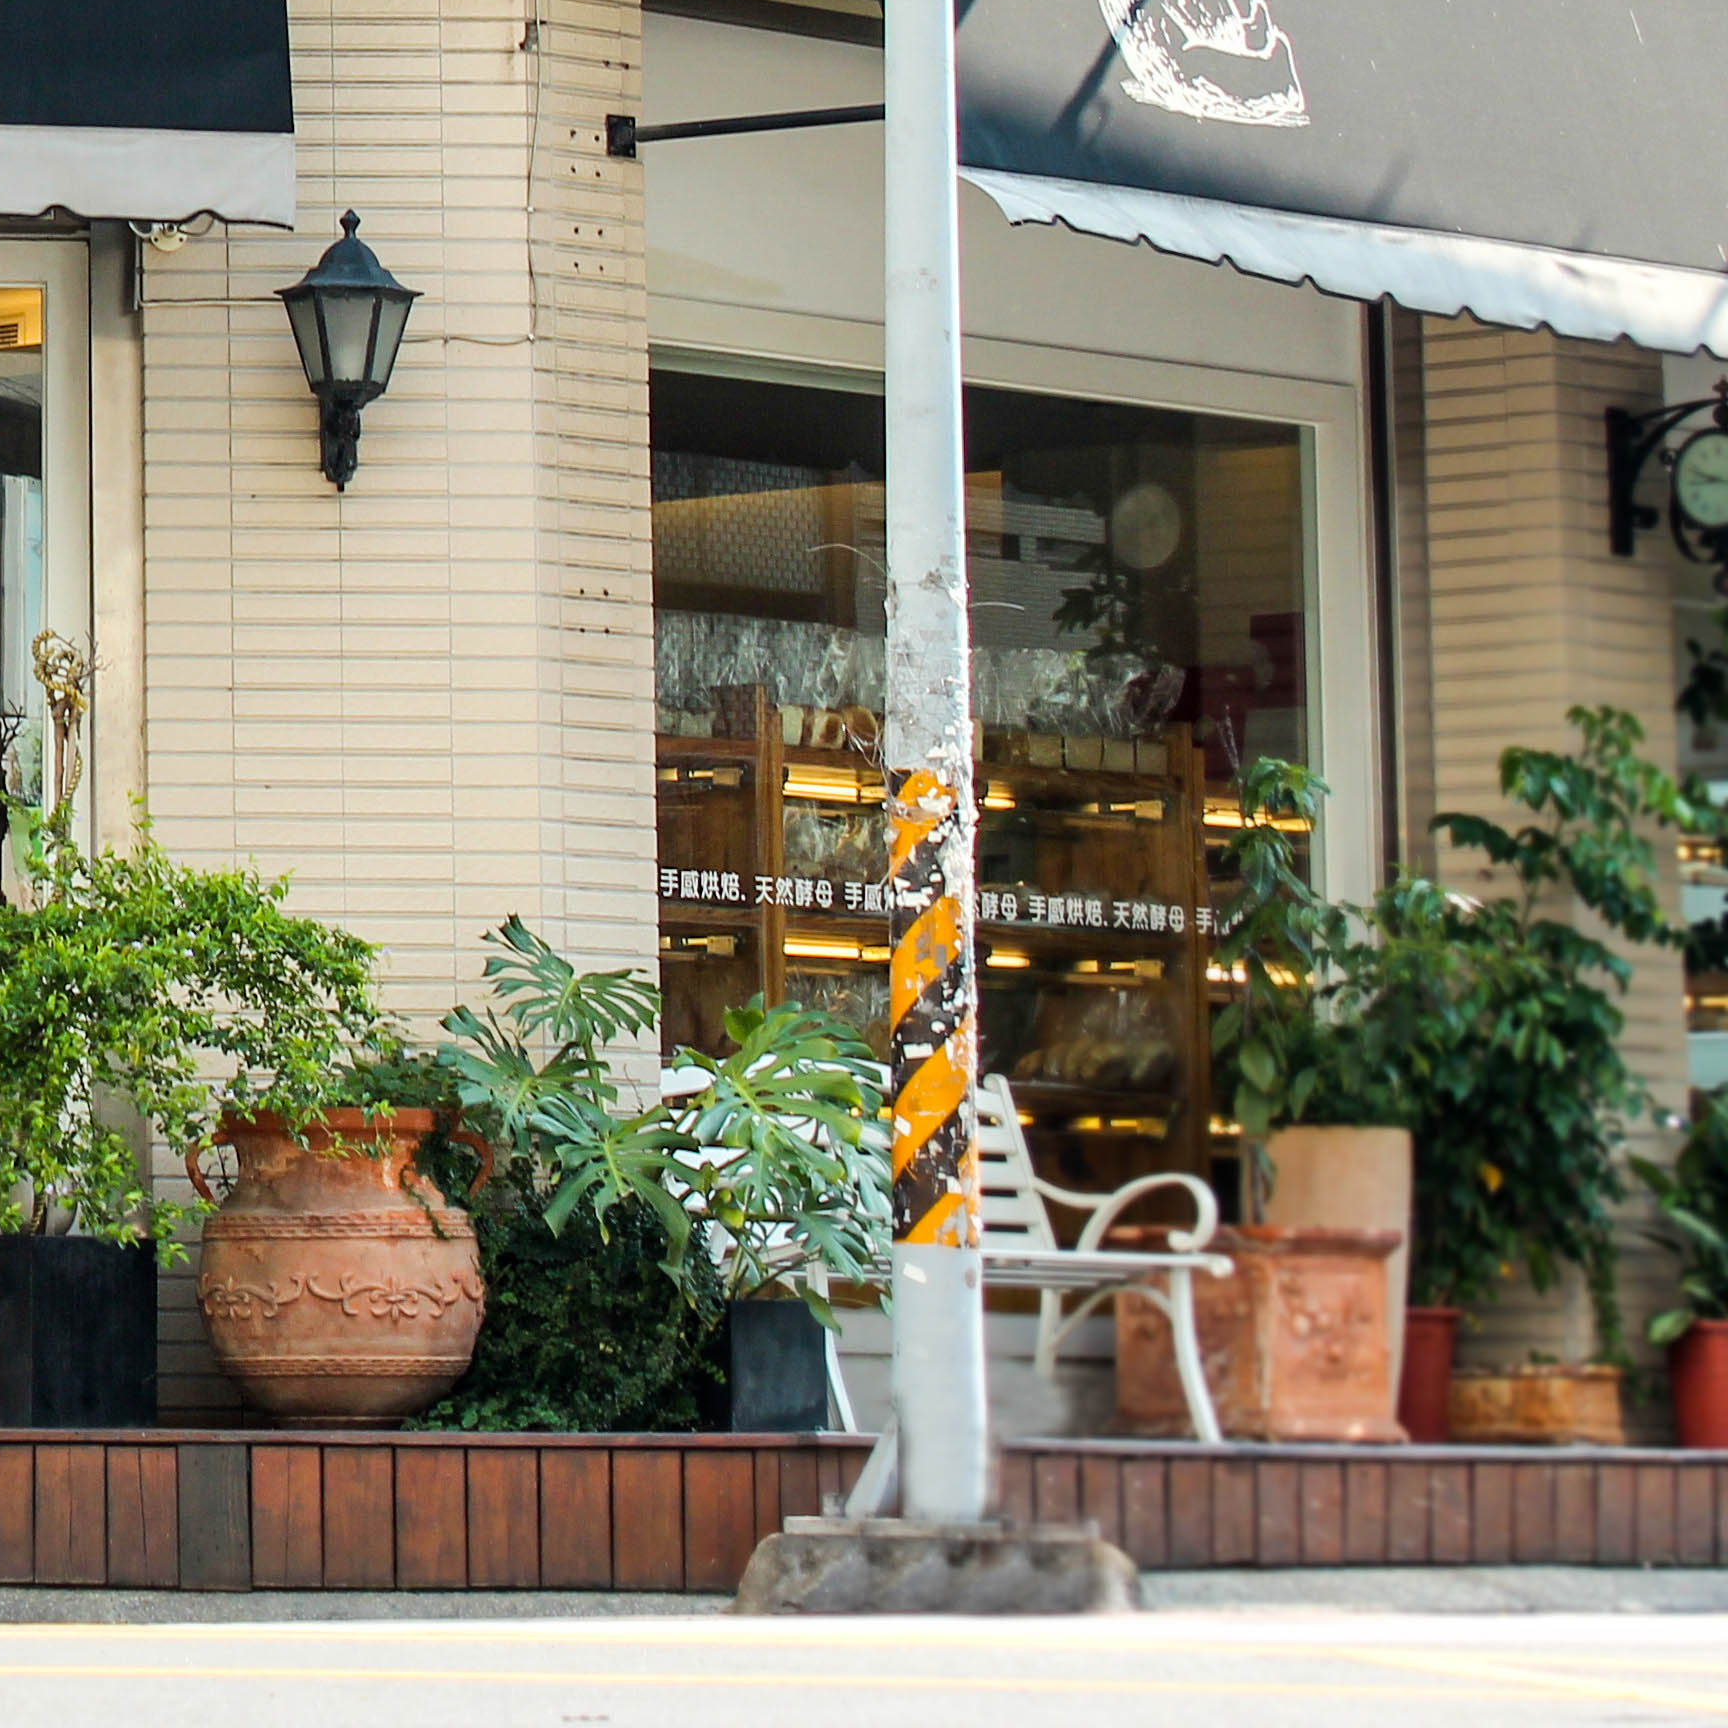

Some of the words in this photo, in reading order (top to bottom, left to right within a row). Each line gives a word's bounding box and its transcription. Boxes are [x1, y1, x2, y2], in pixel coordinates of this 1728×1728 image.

[754, 874, 834, 909] 天然酵母
[1111, 900, 1185, 933] 天然酵母
